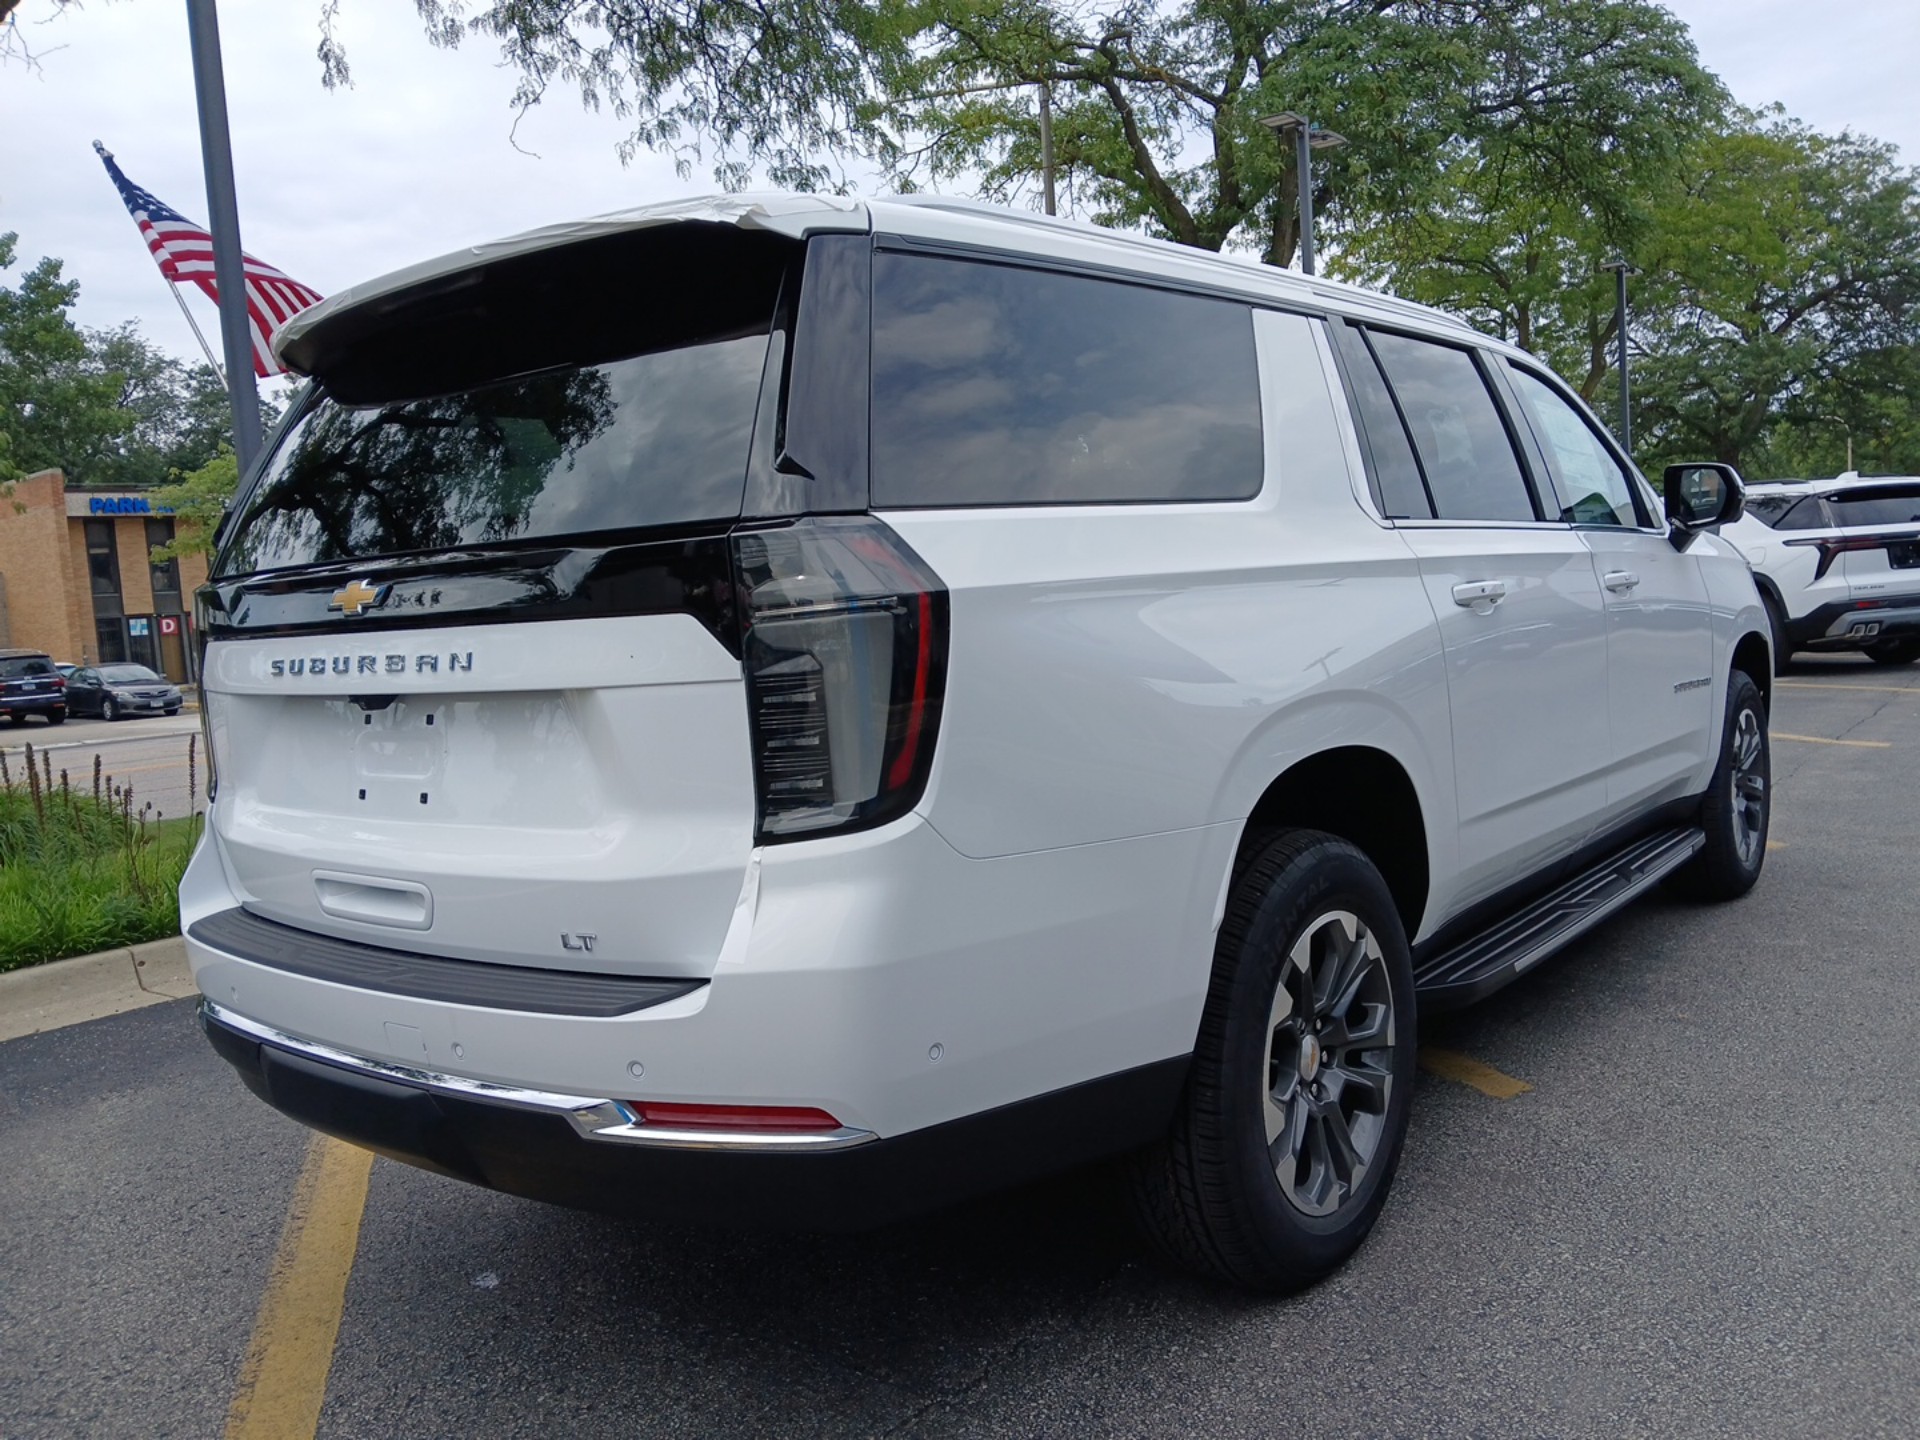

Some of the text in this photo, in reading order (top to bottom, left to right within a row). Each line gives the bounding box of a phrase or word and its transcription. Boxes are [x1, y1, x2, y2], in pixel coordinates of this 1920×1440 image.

[89, 497, 150, 514] PARK
[162, 619, 175, 633] D
[271, 651, 473, 676] SUBURBAN
[560, 932, 597, 951] LT
